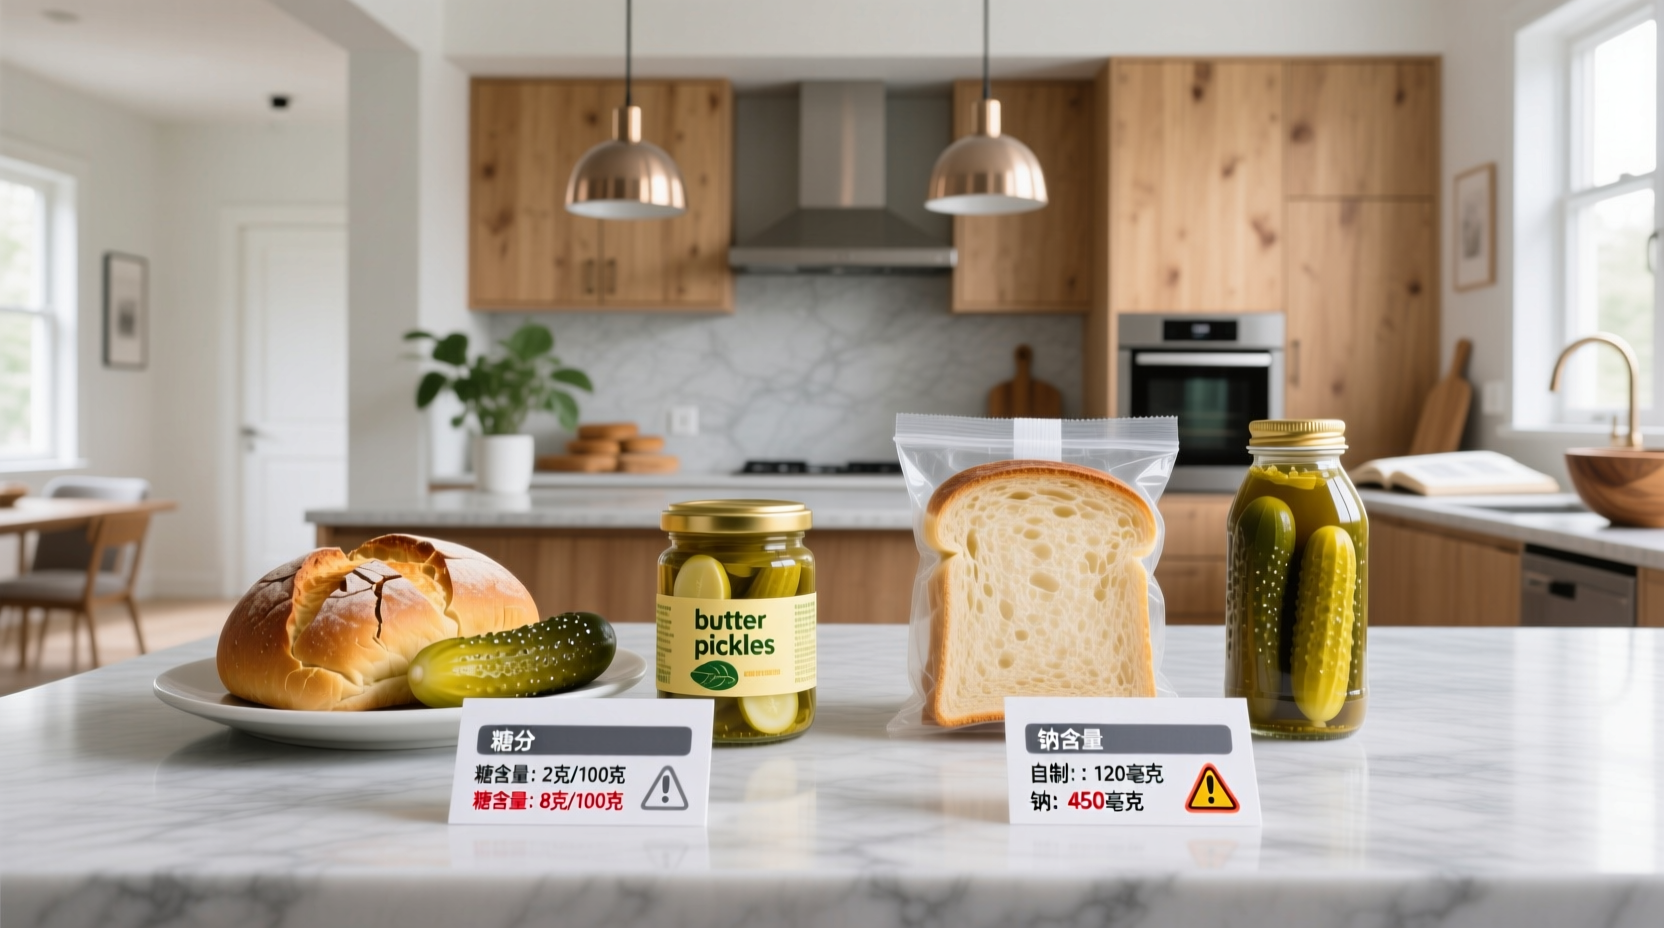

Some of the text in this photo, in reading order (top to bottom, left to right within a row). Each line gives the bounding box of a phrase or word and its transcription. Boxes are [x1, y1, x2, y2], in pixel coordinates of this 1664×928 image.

[695, 608, 766, 631] butter
[694, 633, 775, 660] pickles
[490, 729, 536, 752] 糖分
[1037, 727, 1104, 752] 钠含量
